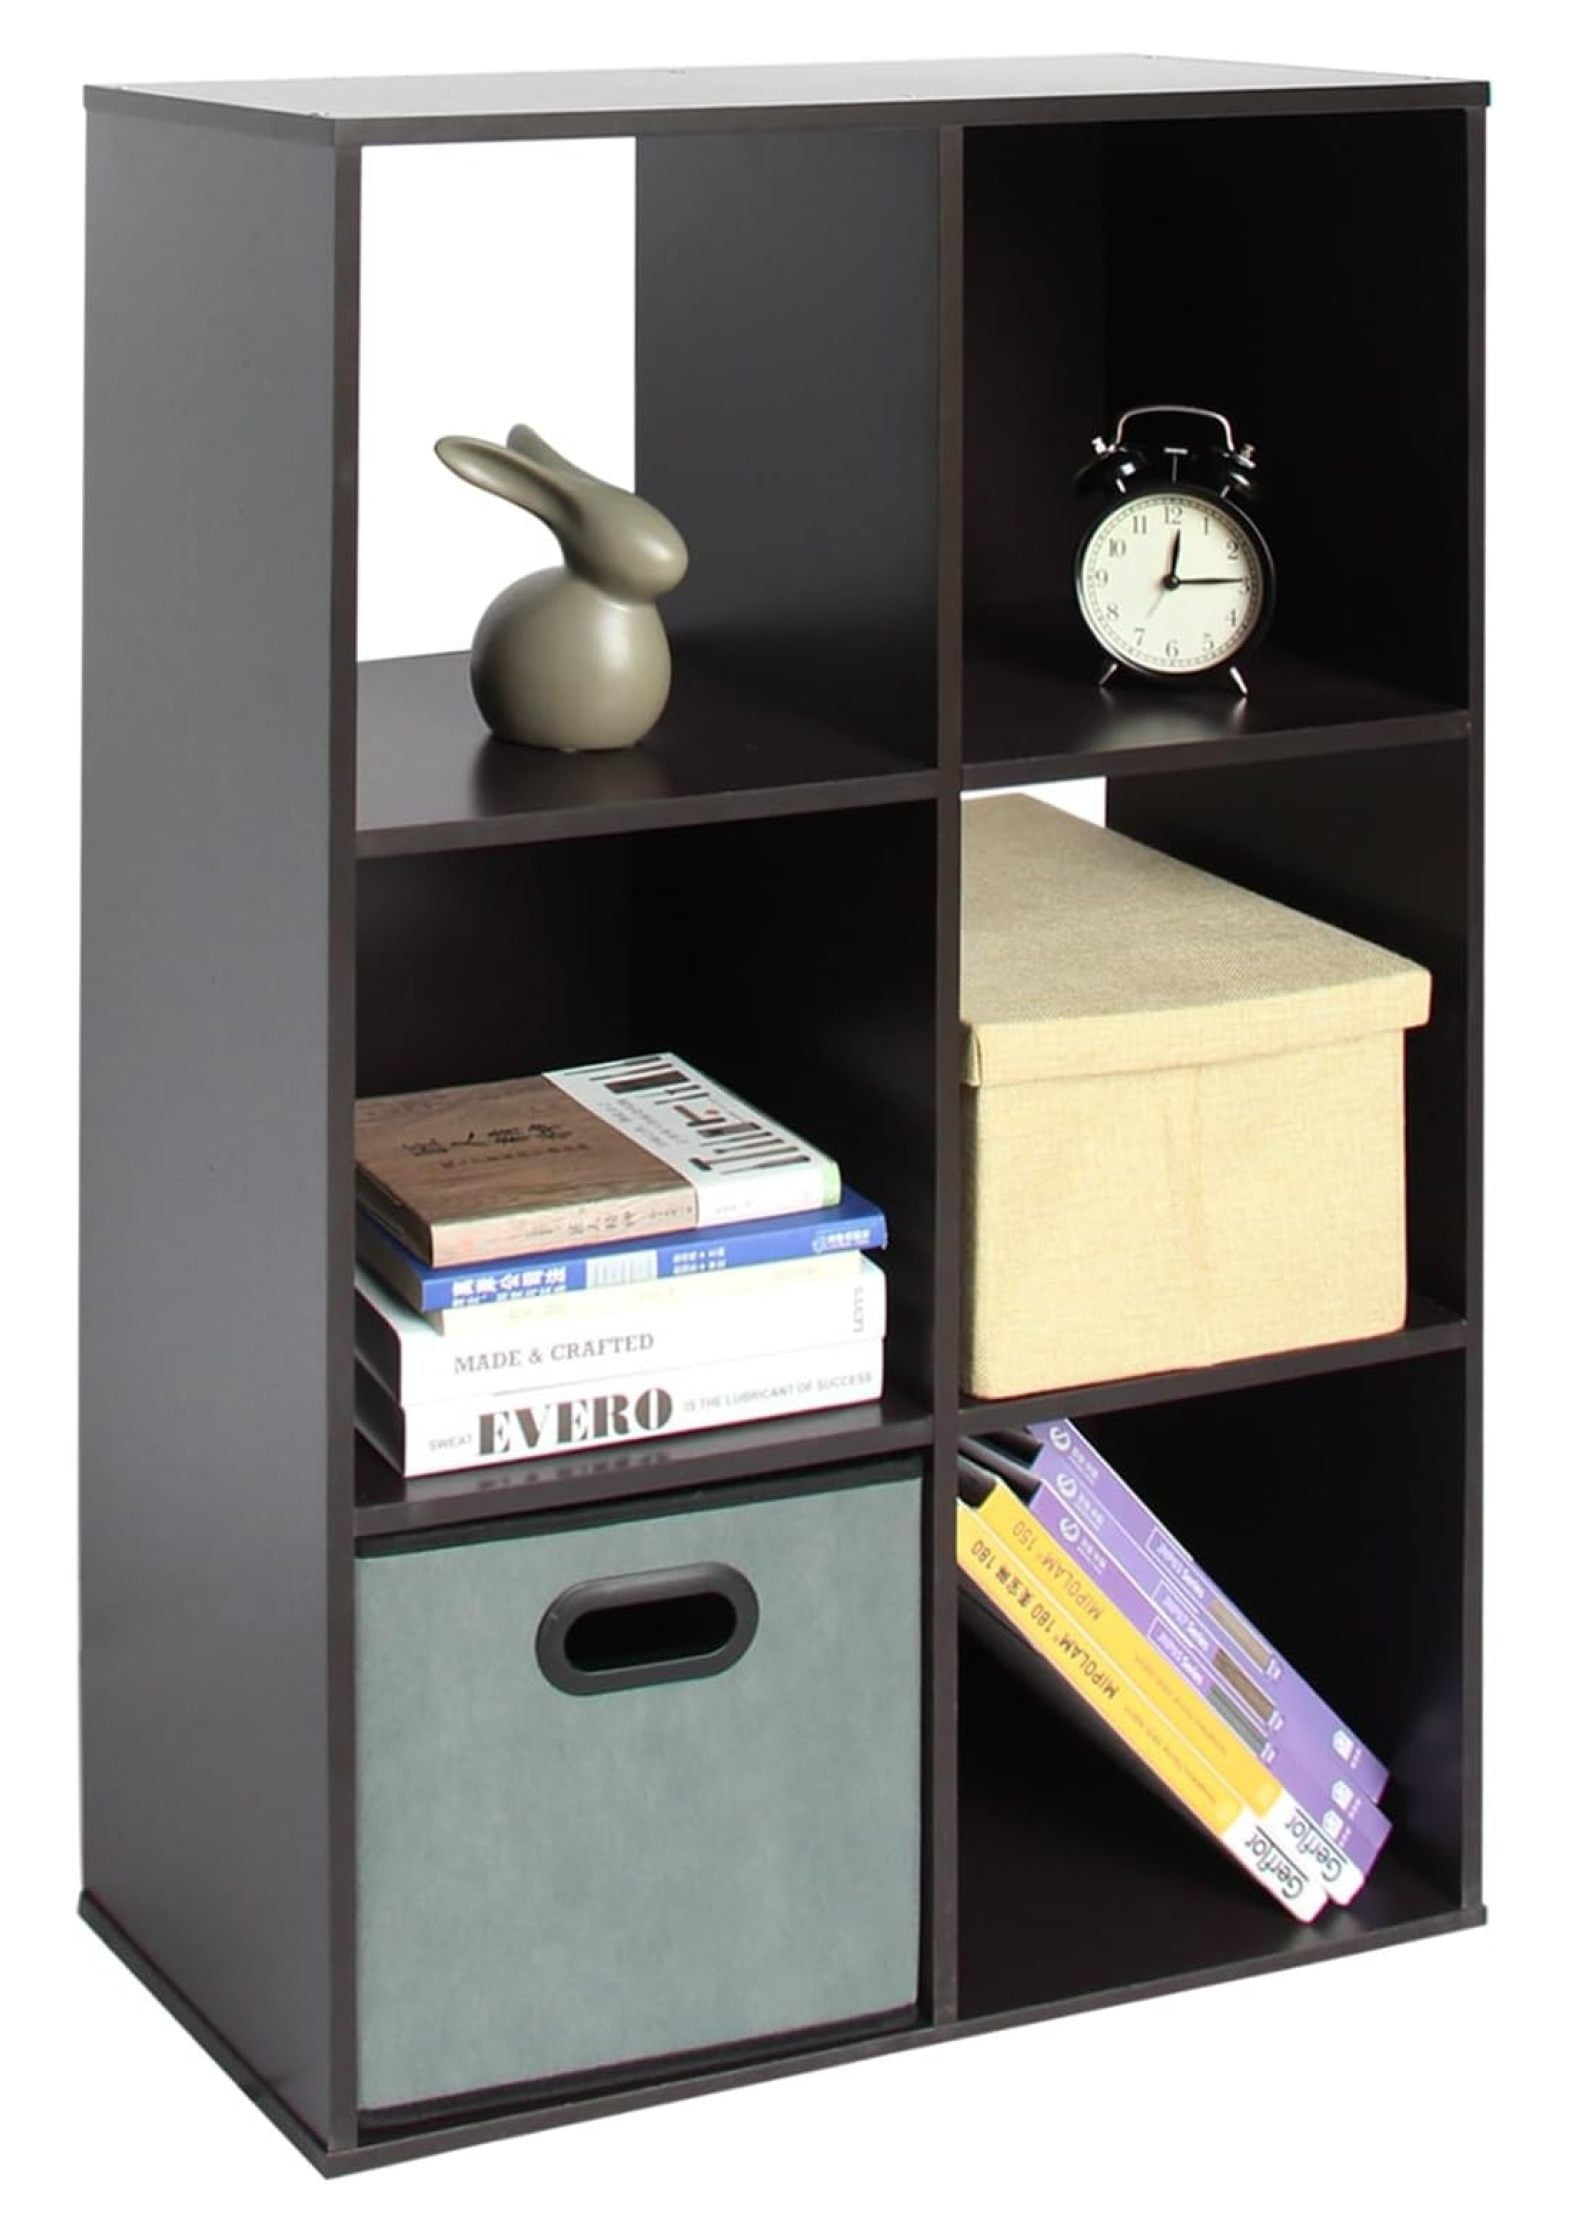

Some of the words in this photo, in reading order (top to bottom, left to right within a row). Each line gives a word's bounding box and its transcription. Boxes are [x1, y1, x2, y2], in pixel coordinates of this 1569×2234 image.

[1163, 505, 1184, 526] 12
[1132, 516, 1148, 535] 11
[1202, 516, 1210, 535] 1
[1108, 539, 1126, 558] 10
[1226, 542, 1240, 561] 2
[1096, 570, 1108, 586] 9
[1106, 604, 1120, 621] 8
[1224, 608, 1238, 626] 4
[1134, 628, 1146, 646] 7
[1202, 634, 1214, 651] 5
[1166, 640, 1179, 658] 6
[453, 1349, 522, 1375] MADE
[527, 1348, 543, 1365] &
[549, 1332, 655, 1362] CRAFTED
[428, 1433, 473, 1452] SWEAT
[478, 1387, 674, 1456] EVERO
[683, 1399, 696, 1413] IS
[699, 1396, 722, 1409] THE
[726, 1384, 794, 1406] LUBRICANT
[796, 1380, 813, 1394] OF
[817, 1371, 873, 1391] SUCCESS
[1012, 1521, 1038, 1551] 150
[971, 1539, 997, 1570] 180
[1030, 1603, 1056, 1633] 180
[1284, 1814, 1342, 1882] Gerflor
[1245, 1832, 1304, 1900] Gerflor
